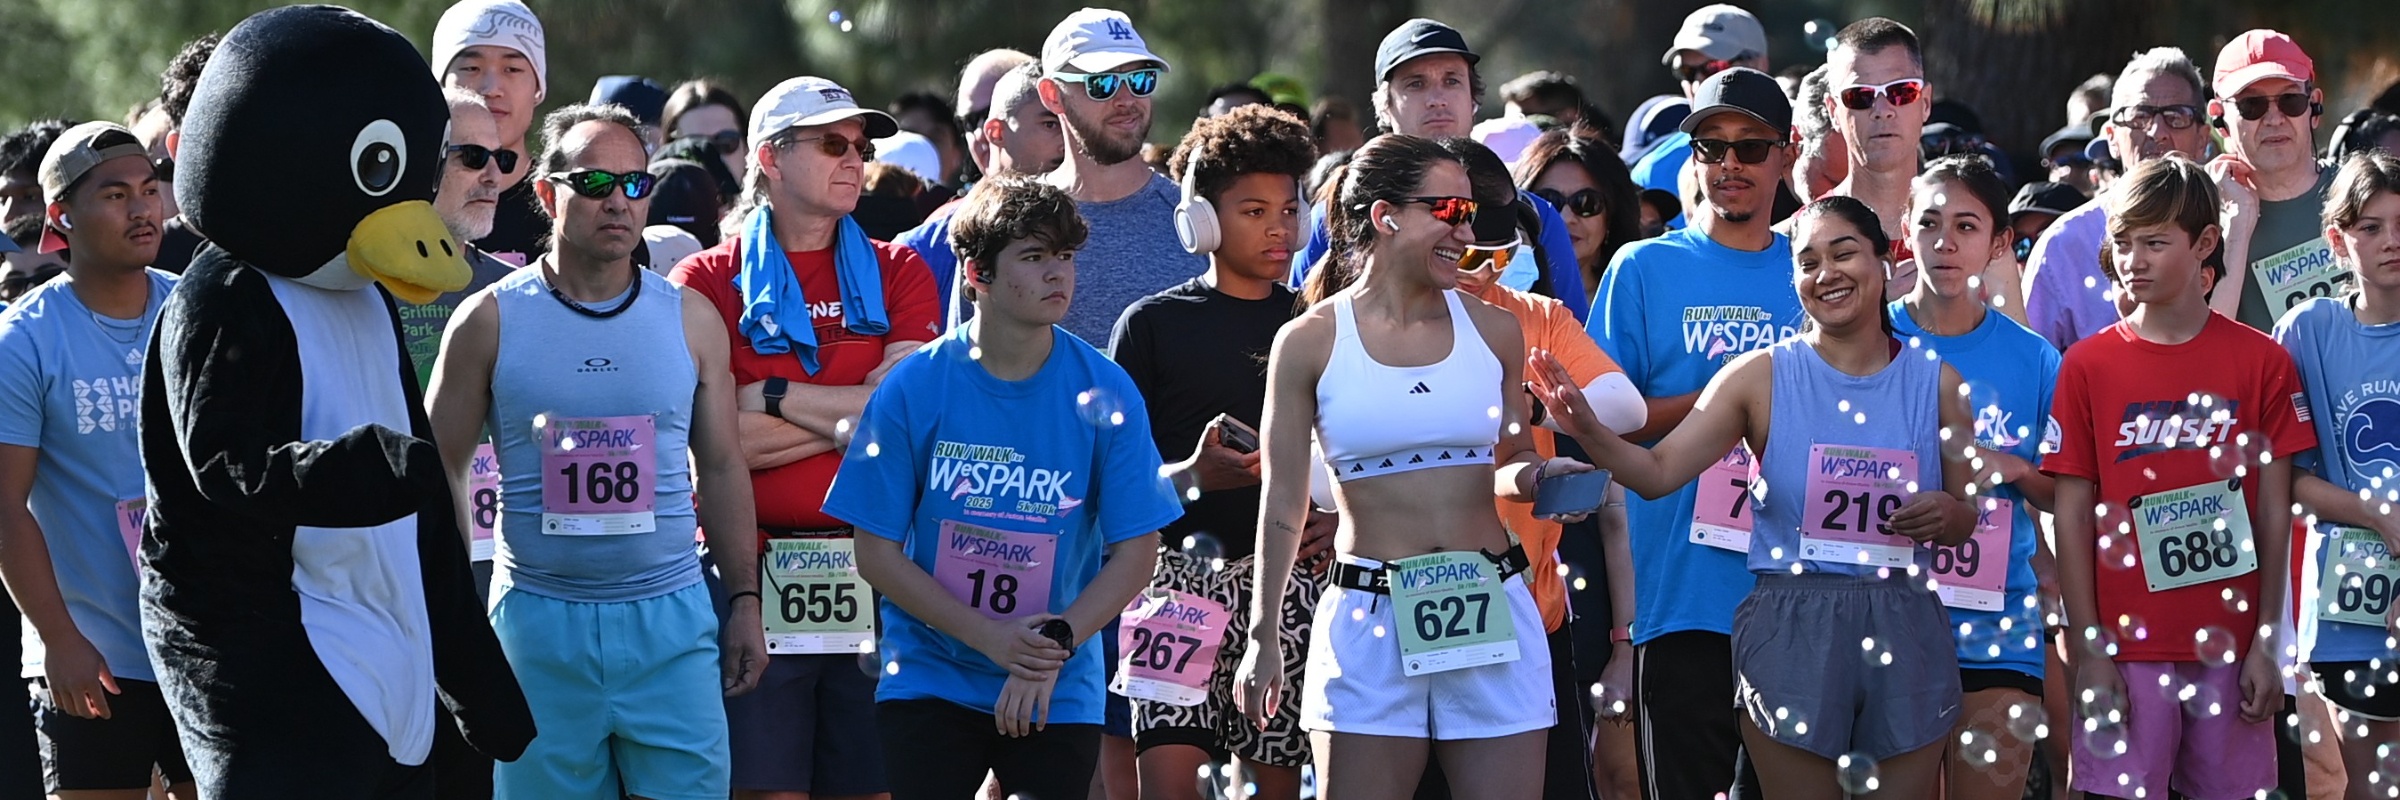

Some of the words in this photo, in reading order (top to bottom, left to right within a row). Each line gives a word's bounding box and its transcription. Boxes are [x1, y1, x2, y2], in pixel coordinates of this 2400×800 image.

[1106, 17, 1133, 40] LA
[2266, 249, 2331, 286] WeSPAR
[399, 305, 453, 319] Griffith
[1683, 306, 1761, 322] RUN/WALK
[402, 323, 434, 336] Park
[1682, 321, 1800, 353] WeSPAR
[2114, 418, 2238, 446] SUNSET
[935, 441, 1014, 463] RUN/WALK
[561, 462, 639, 504] 168
[930, 457, 1072, 503] WeSPARK
[965, 496, 993, 509] 2025
[1016, 501, 1056, 515] 5k/10k
[1821, 490, 1902, 535] 219
[2144, 491, 2190, 507] RUN/WALK
[2144, 494, 2224, 526] WeSPARK
[776, 541, 822, 550] RUN/WALK
[951, 532, 1036, 562] WeSPARK
[2159, 531, 2238, 577] 688
[775, 550, 852, 569] WeSPARK
[1401, 556, 1446, 570] RUN/WALK
[1400, 562, 1479, 589] WeSPARK
[781, 583, 857, 623] 655
[966, 568, 1018, 614] 18
[1153, 602, 1210, 625] PARK
[1414, 593, 1491, 641] 627
[1129, 627, 1202, 674] 267
